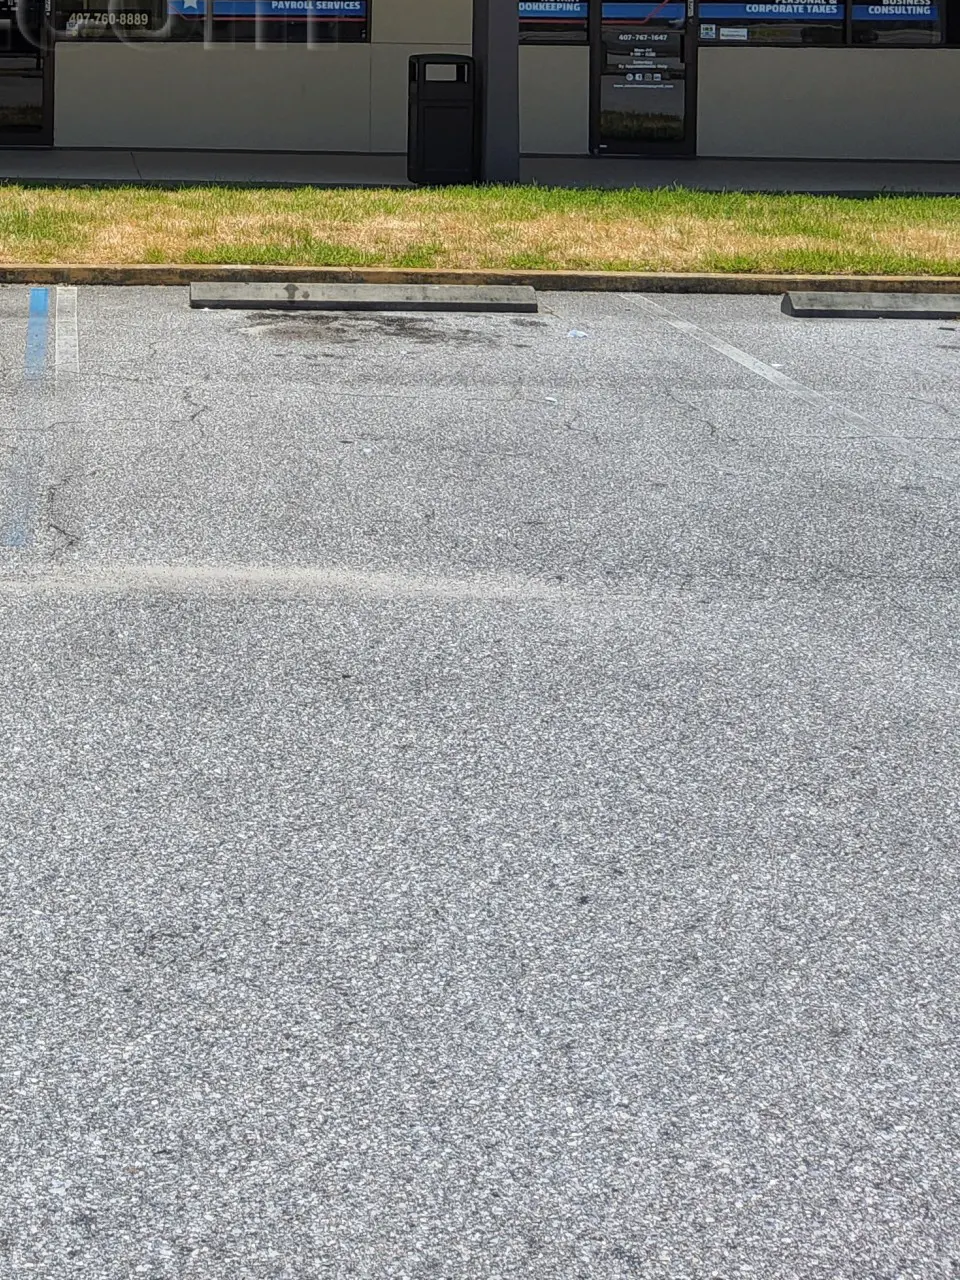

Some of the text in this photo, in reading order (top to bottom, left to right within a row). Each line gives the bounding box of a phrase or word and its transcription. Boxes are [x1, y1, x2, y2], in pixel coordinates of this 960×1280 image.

[271, 0, 360, 10] PAYROLL SERVICES
[746, 4, 837, 13] CORPORATE TAXES
[868, 5, 931, 14] CONSULTING
[69, 12, 149, 25] 407-760-8889
